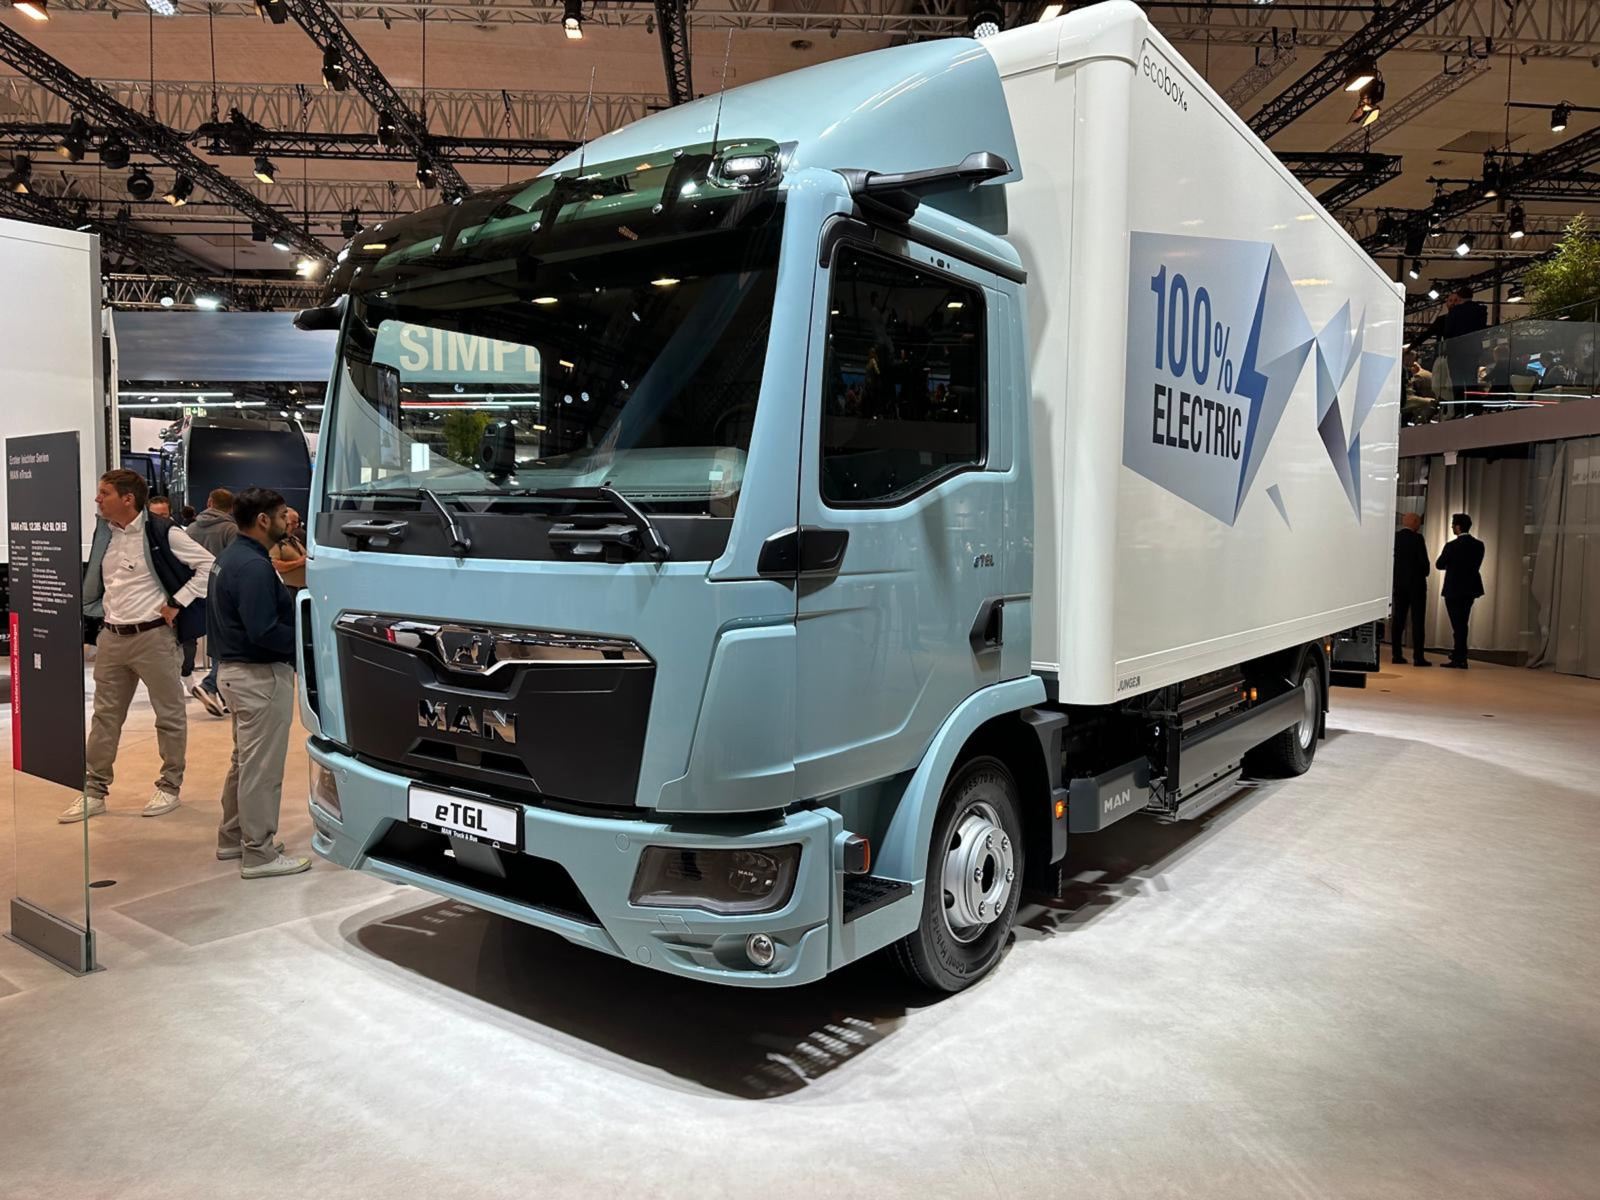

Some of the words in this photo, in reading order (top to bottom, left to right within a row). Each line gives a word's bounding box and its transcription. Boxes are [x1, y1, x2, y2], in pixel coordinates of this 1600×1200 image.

[1143, 55, 1184, 110] ecobox
[1151, 264, 1233, 394] 100%
[1152, 383, 1242, 460] ELECTRIC
[9, 455, 20, 465] Erster
[21, 453, 35, 464] leichter
[36, 452, 49, 463] Serien
[10, 470, 19, 480] MAN
[20, 469, 32, 479] eTruck
[11, 522, 19, 531] MAN
[418, 699, 518, 744] MAN
[1104, 789, 1130, 813] MAN
[435, 803, 488, 832] eTGL
[441, 827, 452, 836] MAN
[453, 830, 465, 839] Truck
[469, 834, 478, 843] Bus
